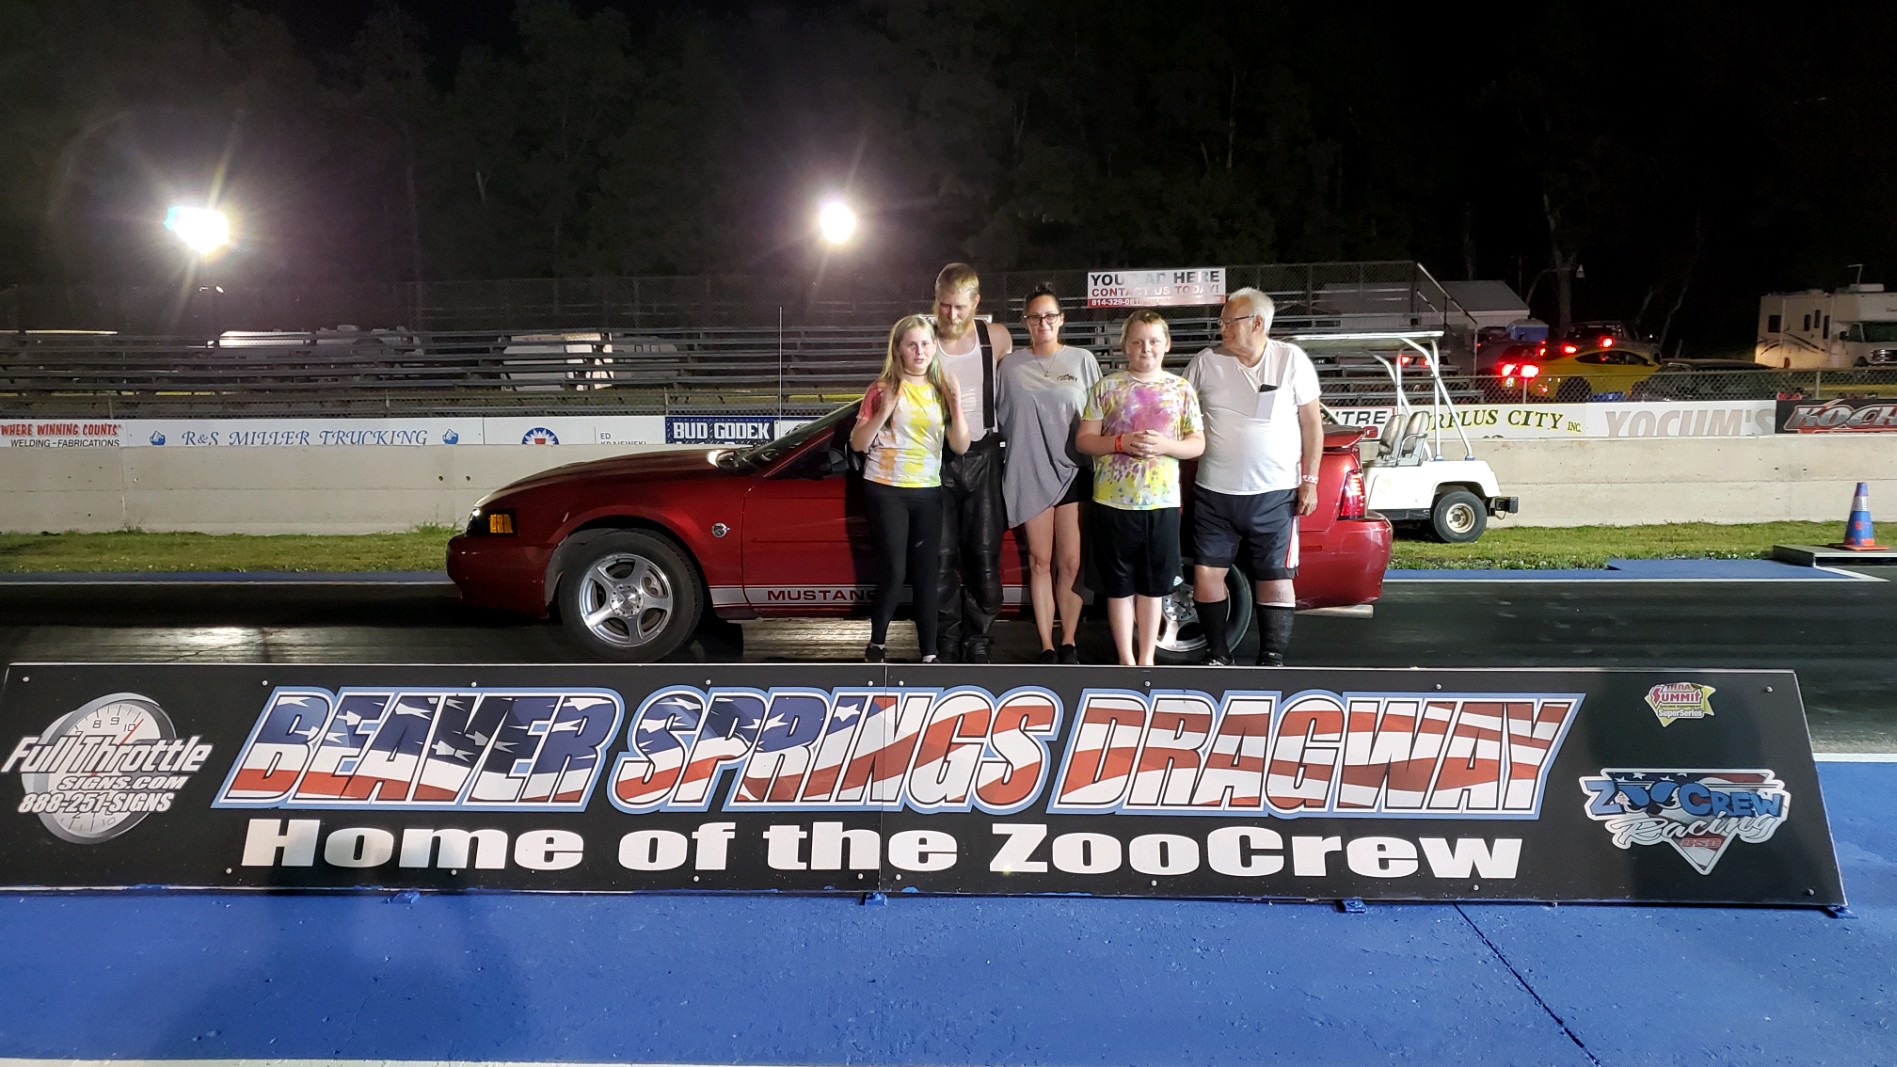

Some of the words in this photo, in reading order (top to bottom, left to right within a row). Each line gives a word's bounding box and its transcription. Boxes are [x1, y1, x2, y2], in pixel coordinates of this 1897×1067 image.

[1091, 273, 1136, 286] YOU
[1173, 270, 1220, 284] HERE
[1091, 286, 1148, 297] CONTACT
[1154, 285, 1170, 295] US
[1335, 411, 1388, 424] TRE
[1507, 409, 1564, 429] CITY
[1, 423, 33, 436] WHERE
[37, 423, 79, 436] WINNING
[181, 430, 219, 446] R&S
[228, 430, 311, 446] MILLER
[319, 429, 428, 446] TRUCKING
[600, 432, 611, 440] ED
[673, 422, 708, 439] BUD
[714, 422, 771, 439] GODEK
[211, 686, 625, 812] BEAVER
[607, 685, 1063, 815] SPRINGS
[1046, 688, 1585, 819] DRAGWAY
[57, 775, 190, 791] SIGNS.COM
[17, 792, 175, 813] 888-251-SIGNS
[1610, 811, 1776, 845] Racing
[241, 818, 585, 870] Home
[618, 821, 737, 872] of
[763, 821, 958, 872] the
[989, 823, 1523, 878] ZooCrew
